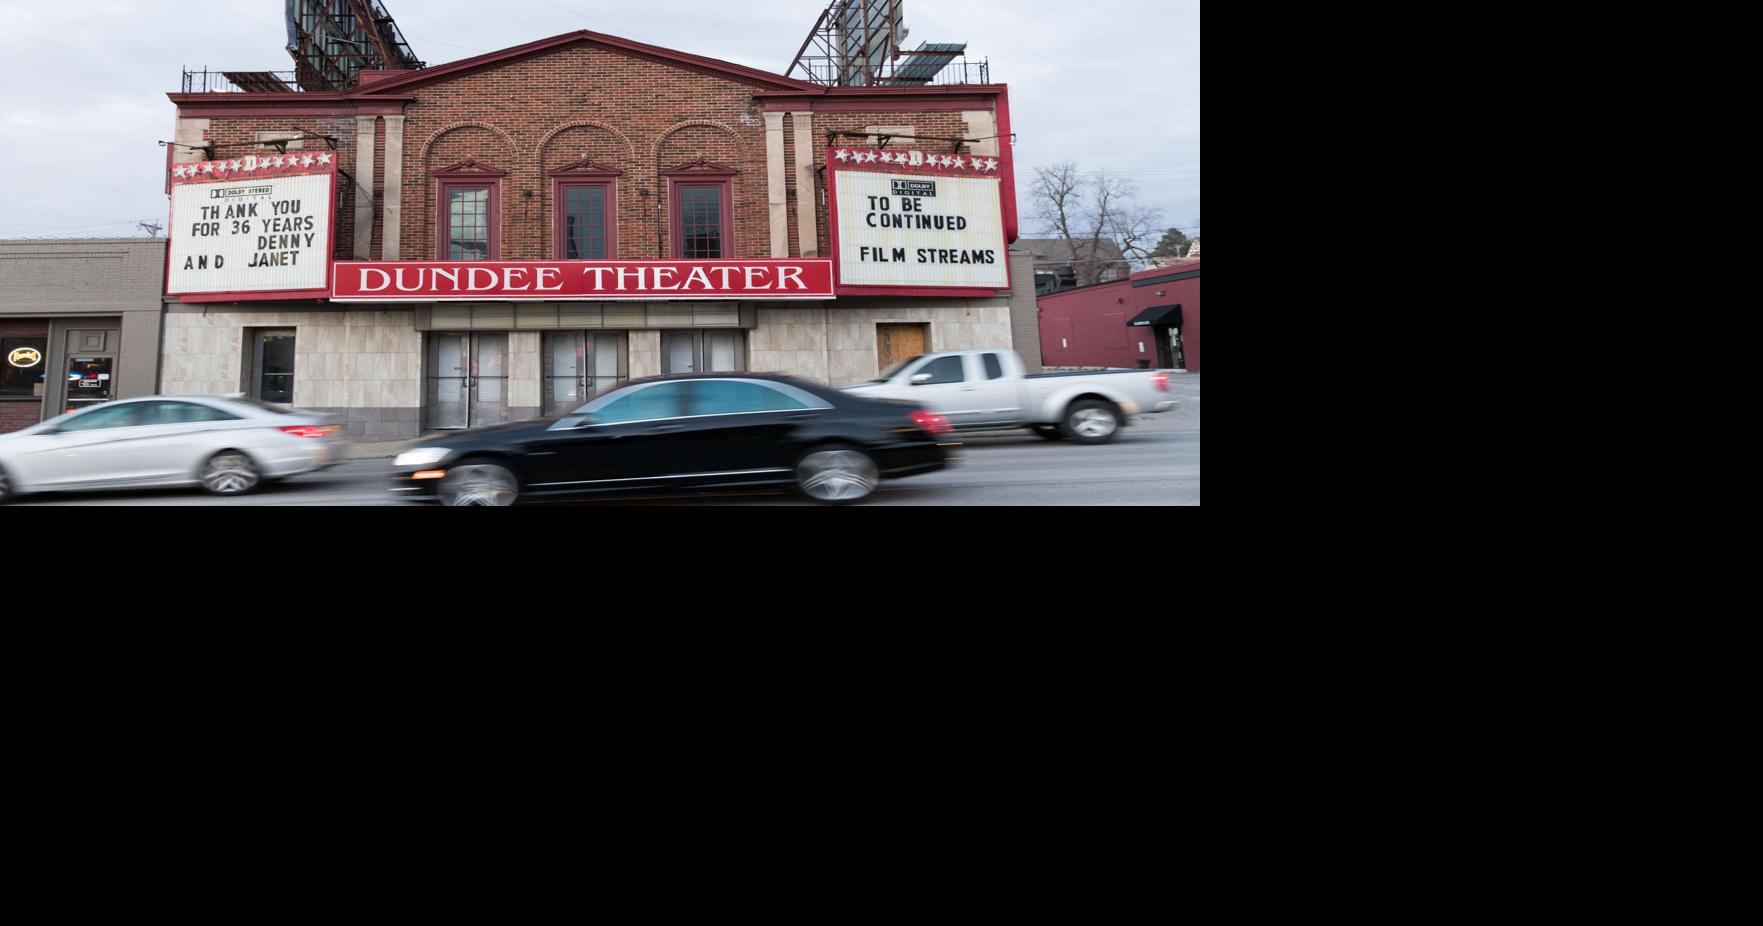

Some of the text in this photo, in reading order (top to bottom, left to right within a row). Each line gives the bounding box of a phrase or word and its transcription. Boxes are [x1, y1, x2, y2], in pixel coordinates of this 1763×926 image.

[201, 200, 301, 220] THANK YOU
[868, 196, 922, 212] TO BE
[192, 215, 314, 237] FOR 36 YEARS
[866, 213, 967, 231] CONTINUED
[258, 233, 315, 251] DENNY
[184, 251, 299, 270] AND JANET
[860, 246, 995, 264] FILM STREAMS
[357, 266, 808, 292] DUNDEE THEATER
